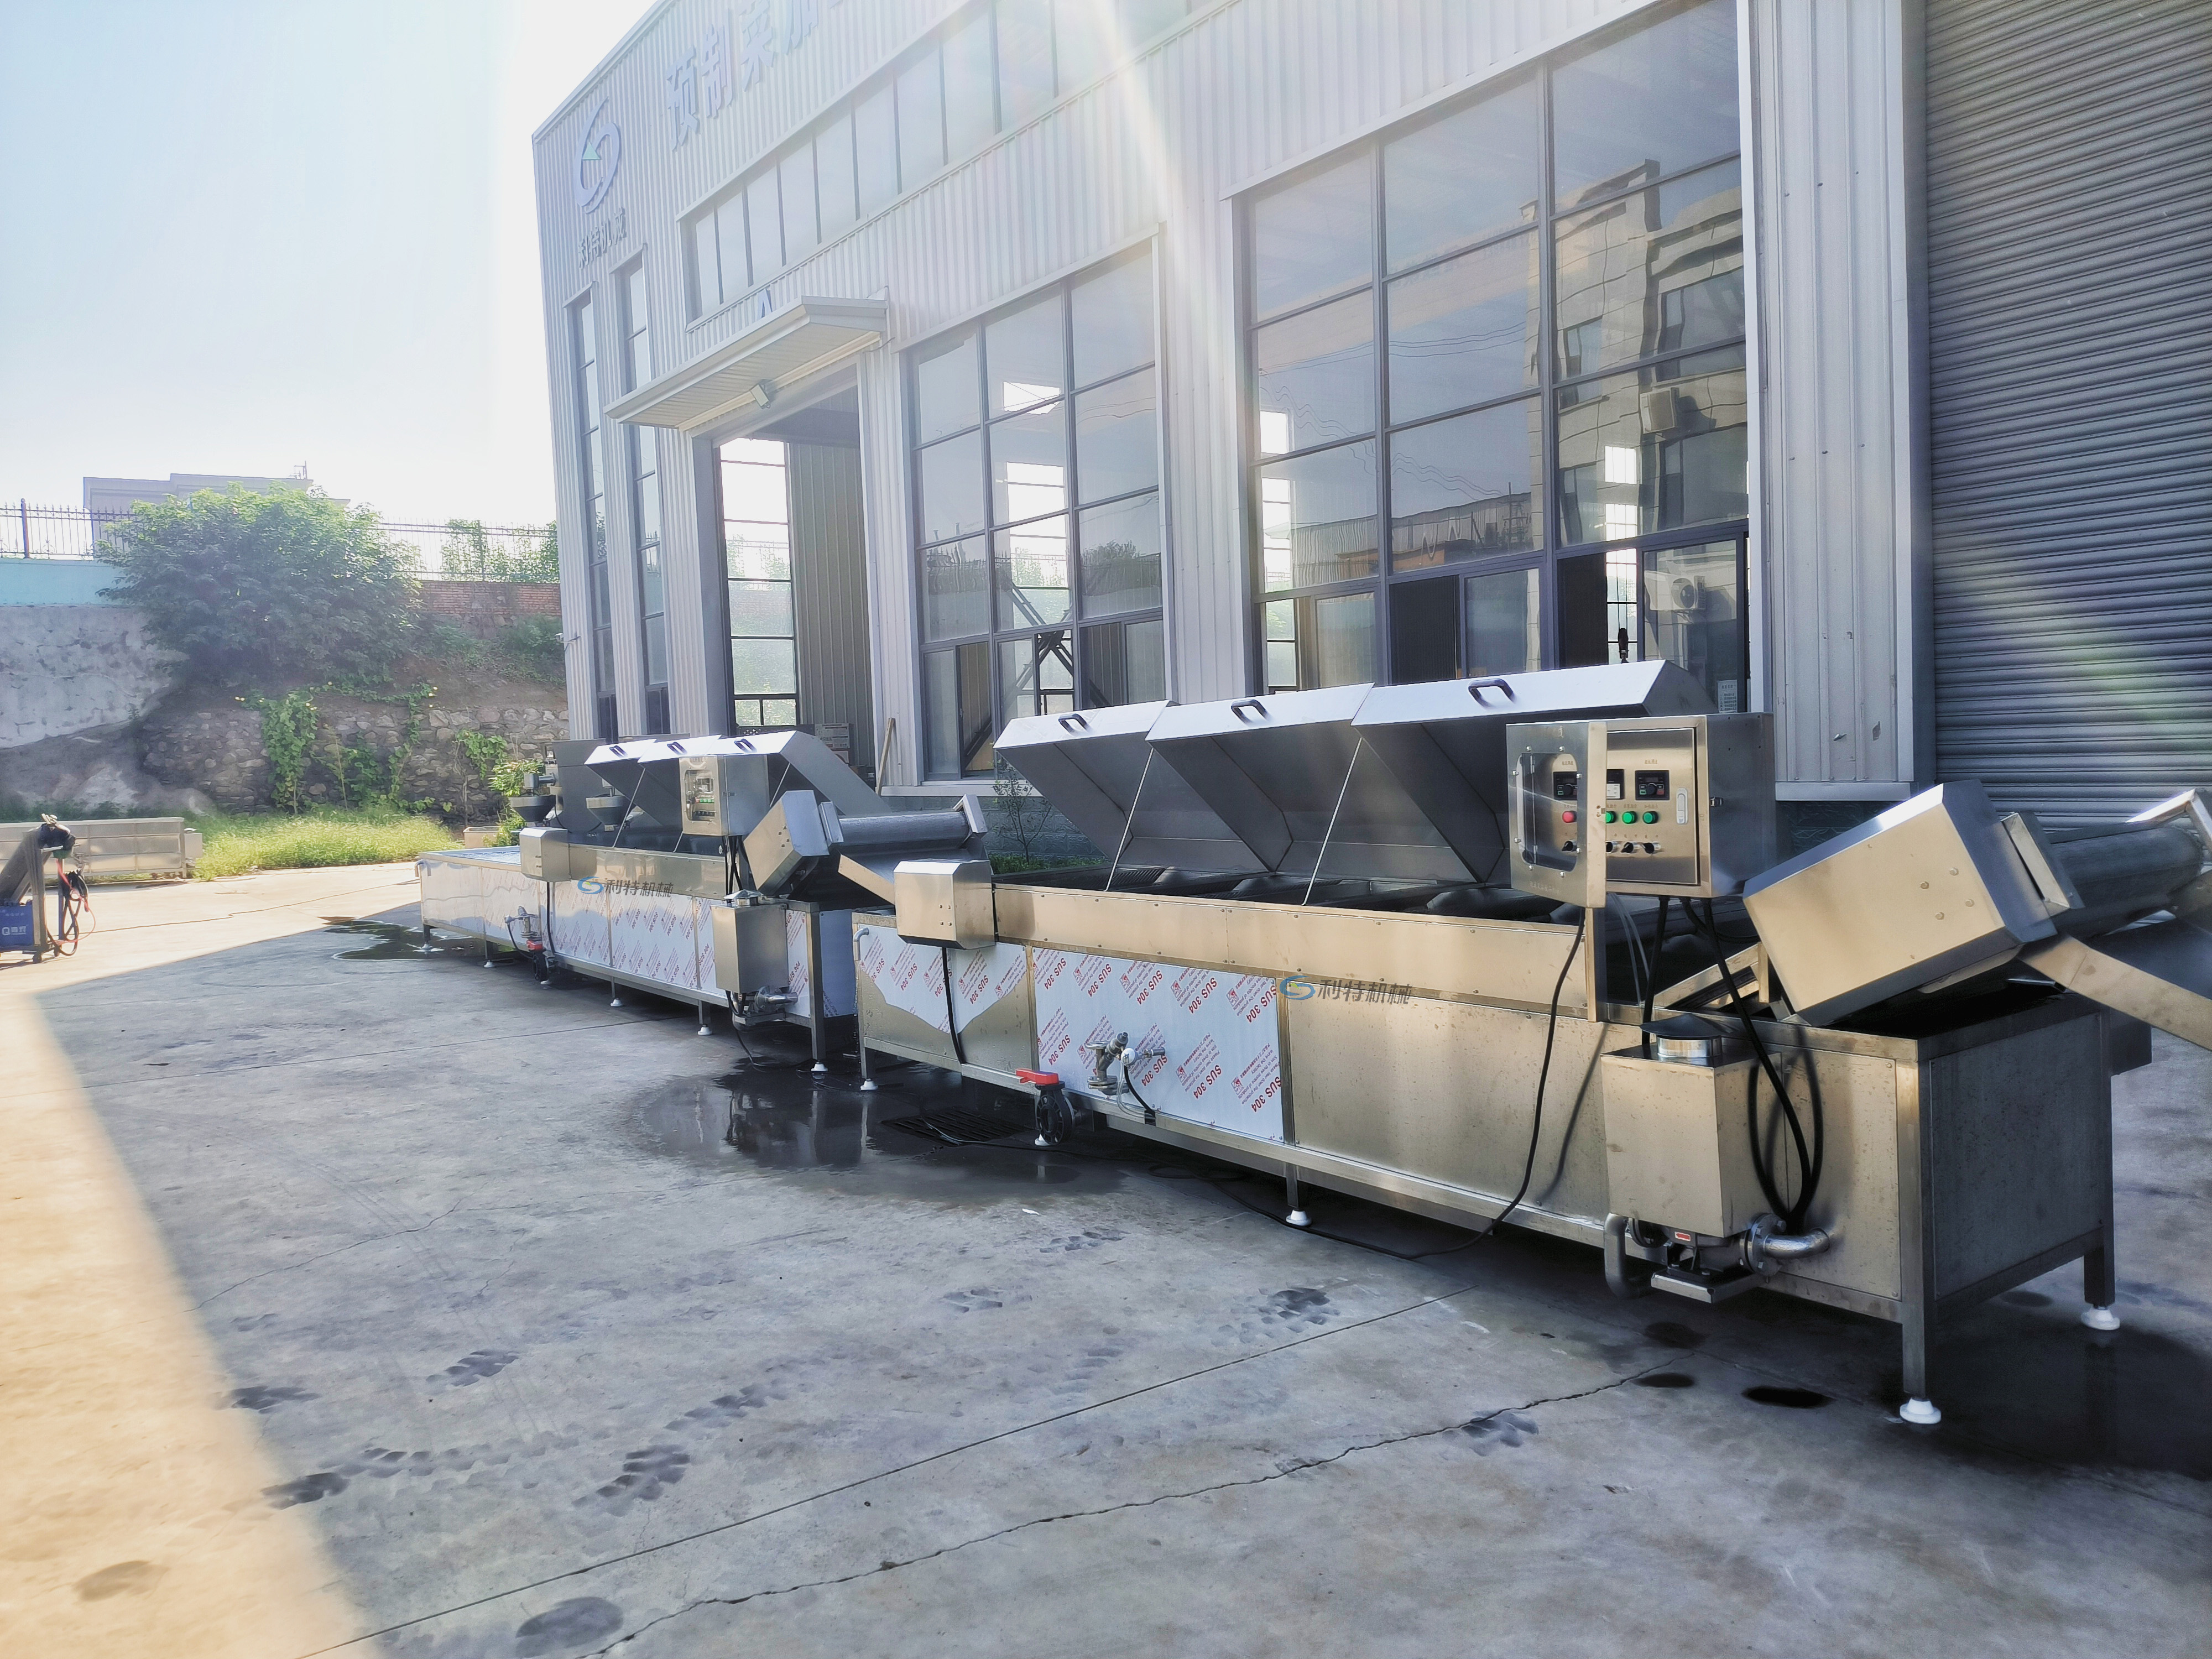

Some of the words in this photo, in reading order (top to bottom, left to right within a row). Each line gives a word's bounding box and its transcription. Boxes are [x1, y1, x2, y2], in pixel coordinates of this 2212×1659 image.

[578, 206, 627, 269] 利特机械
[907, 963, 918, 979] SUS
[1054, 958, 1066, 976] SUS
[1098, 963, 1111, 983] SUS
[900, 977, 909, 991] 304
[978, 975, 989, 992] SUS
[1045, 974, 1054, 989] 304
[1088, 981, 1098, 997] 304
[1149, 971, 1162, 990] SUS
[1202, 978, 1217, 998] SUS
[935, 983, 943, 997] 304
[969, 990, 979, 1005] 304
[1137, 988, 1149, 1005] 304
[1261, 985, 1277, 1006] SUS
[1188, 997, 1201, 1014] 304
[1246, 1005, 1260, 1022] 304
[1058, 1035, 1070, 1052] SUS
[1048, 1051, 1058, 1066] 304
[1141, 1071, 1153, 1087] 304
[1206, 1065, 1221, 1085] SUS
[1193, 1082, 1206, 1099] 304
[1265, 1077, 1284, 1098] SUS
[1251, 1095, 1265, 1112] 304
